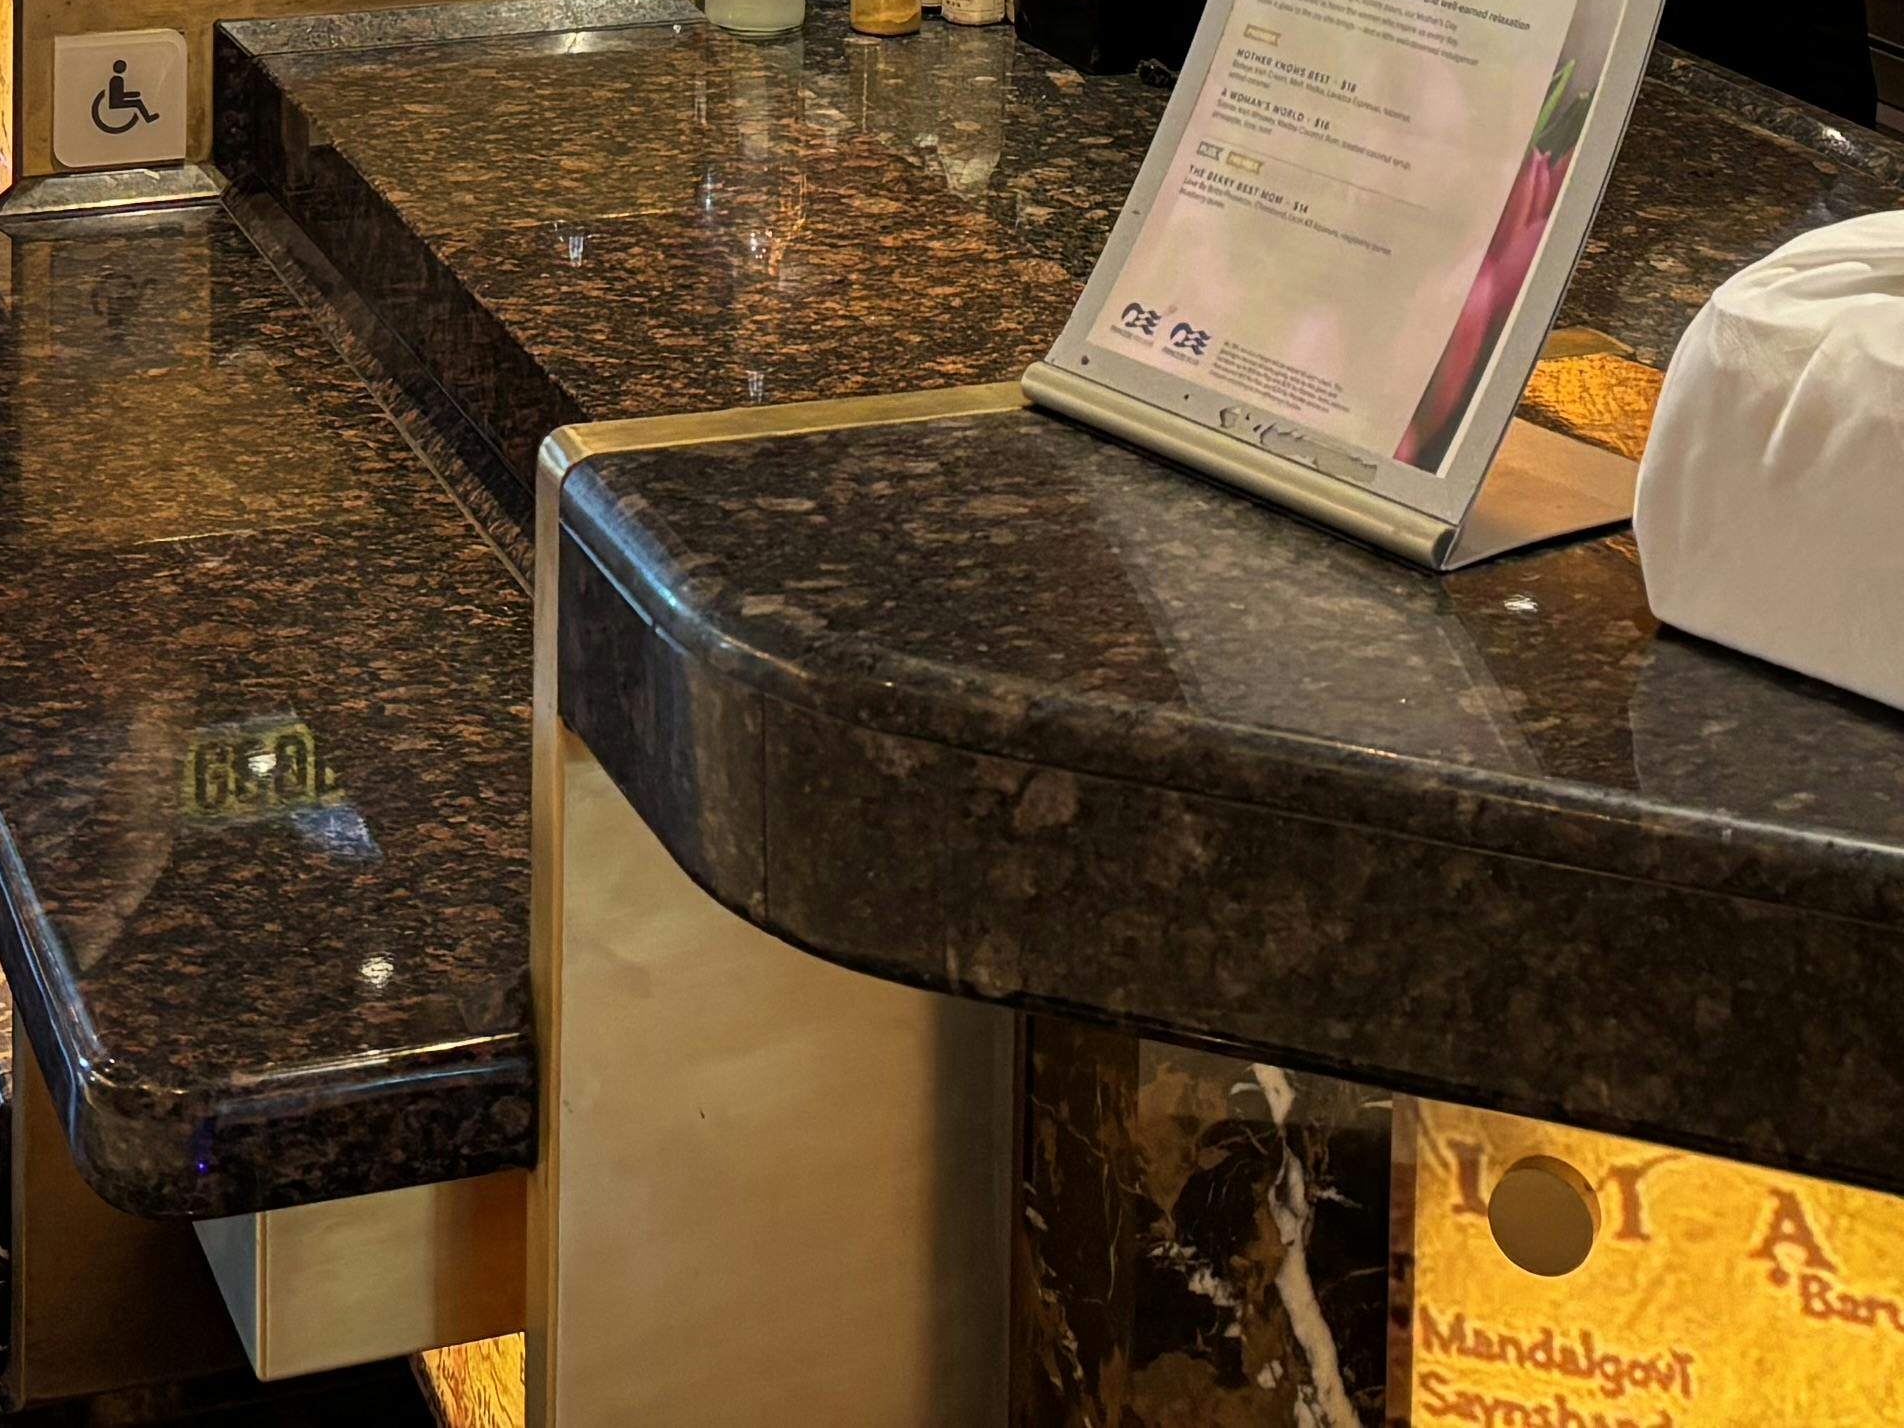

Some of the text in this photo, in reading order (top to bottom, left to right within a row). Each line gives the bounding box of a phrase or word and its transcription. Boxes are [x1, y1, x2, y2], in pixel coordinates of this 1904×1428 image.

[1488, 10, 1531, 32] relaxation
[1236, 47, 1273, 67] MOTHER
[1274, 59, 1306, 78] KNOWS
[1307, 70, 1331, 85] BEST
[1229, 92, 1271, 112] WOMAN'S
[1272, 103, 1305, 123] WORLD
[1188, 163, 1205, 178] THE
[1236, 181, 1260, 197] BEST
[1260, 188, 1284, 206] MOM
